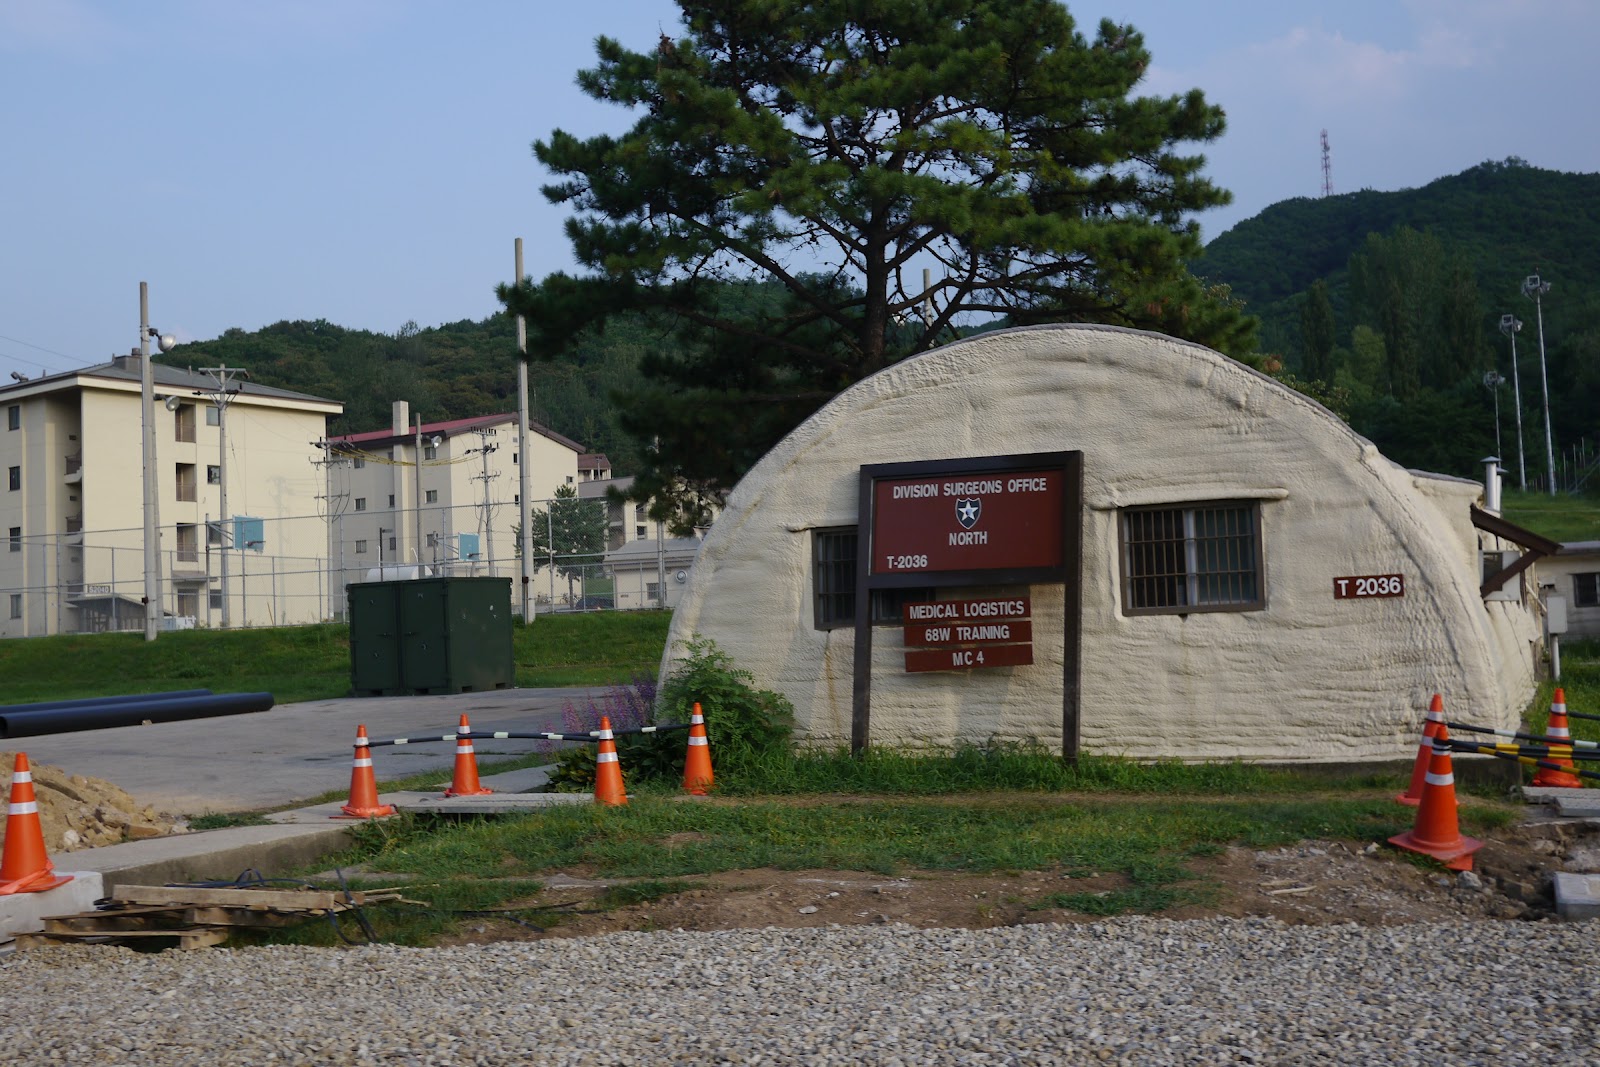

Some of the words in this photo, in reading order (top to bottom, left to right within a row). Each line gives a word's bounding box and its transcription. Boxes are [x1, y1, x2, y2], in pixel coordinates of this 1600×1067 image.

[893, 484, 938, 499] DIVISION
[943, 480, 1002, 496] SURGEONS
[1007, 478, 1047, 493] OFFICE
[949, 531, 988, 545] NORTH
[887, 555, 928, 569] T-2036
[1337, 580, 1349, 596] T
[1356, 577, 1401, 595] 2036
[909, 604, 959, 619] MEDICAL
[964, 601, 1025, 617] LOGISTICS
[925, 628, 951, 641] 68W
[957, 625, 1010, 640] TRAINING
